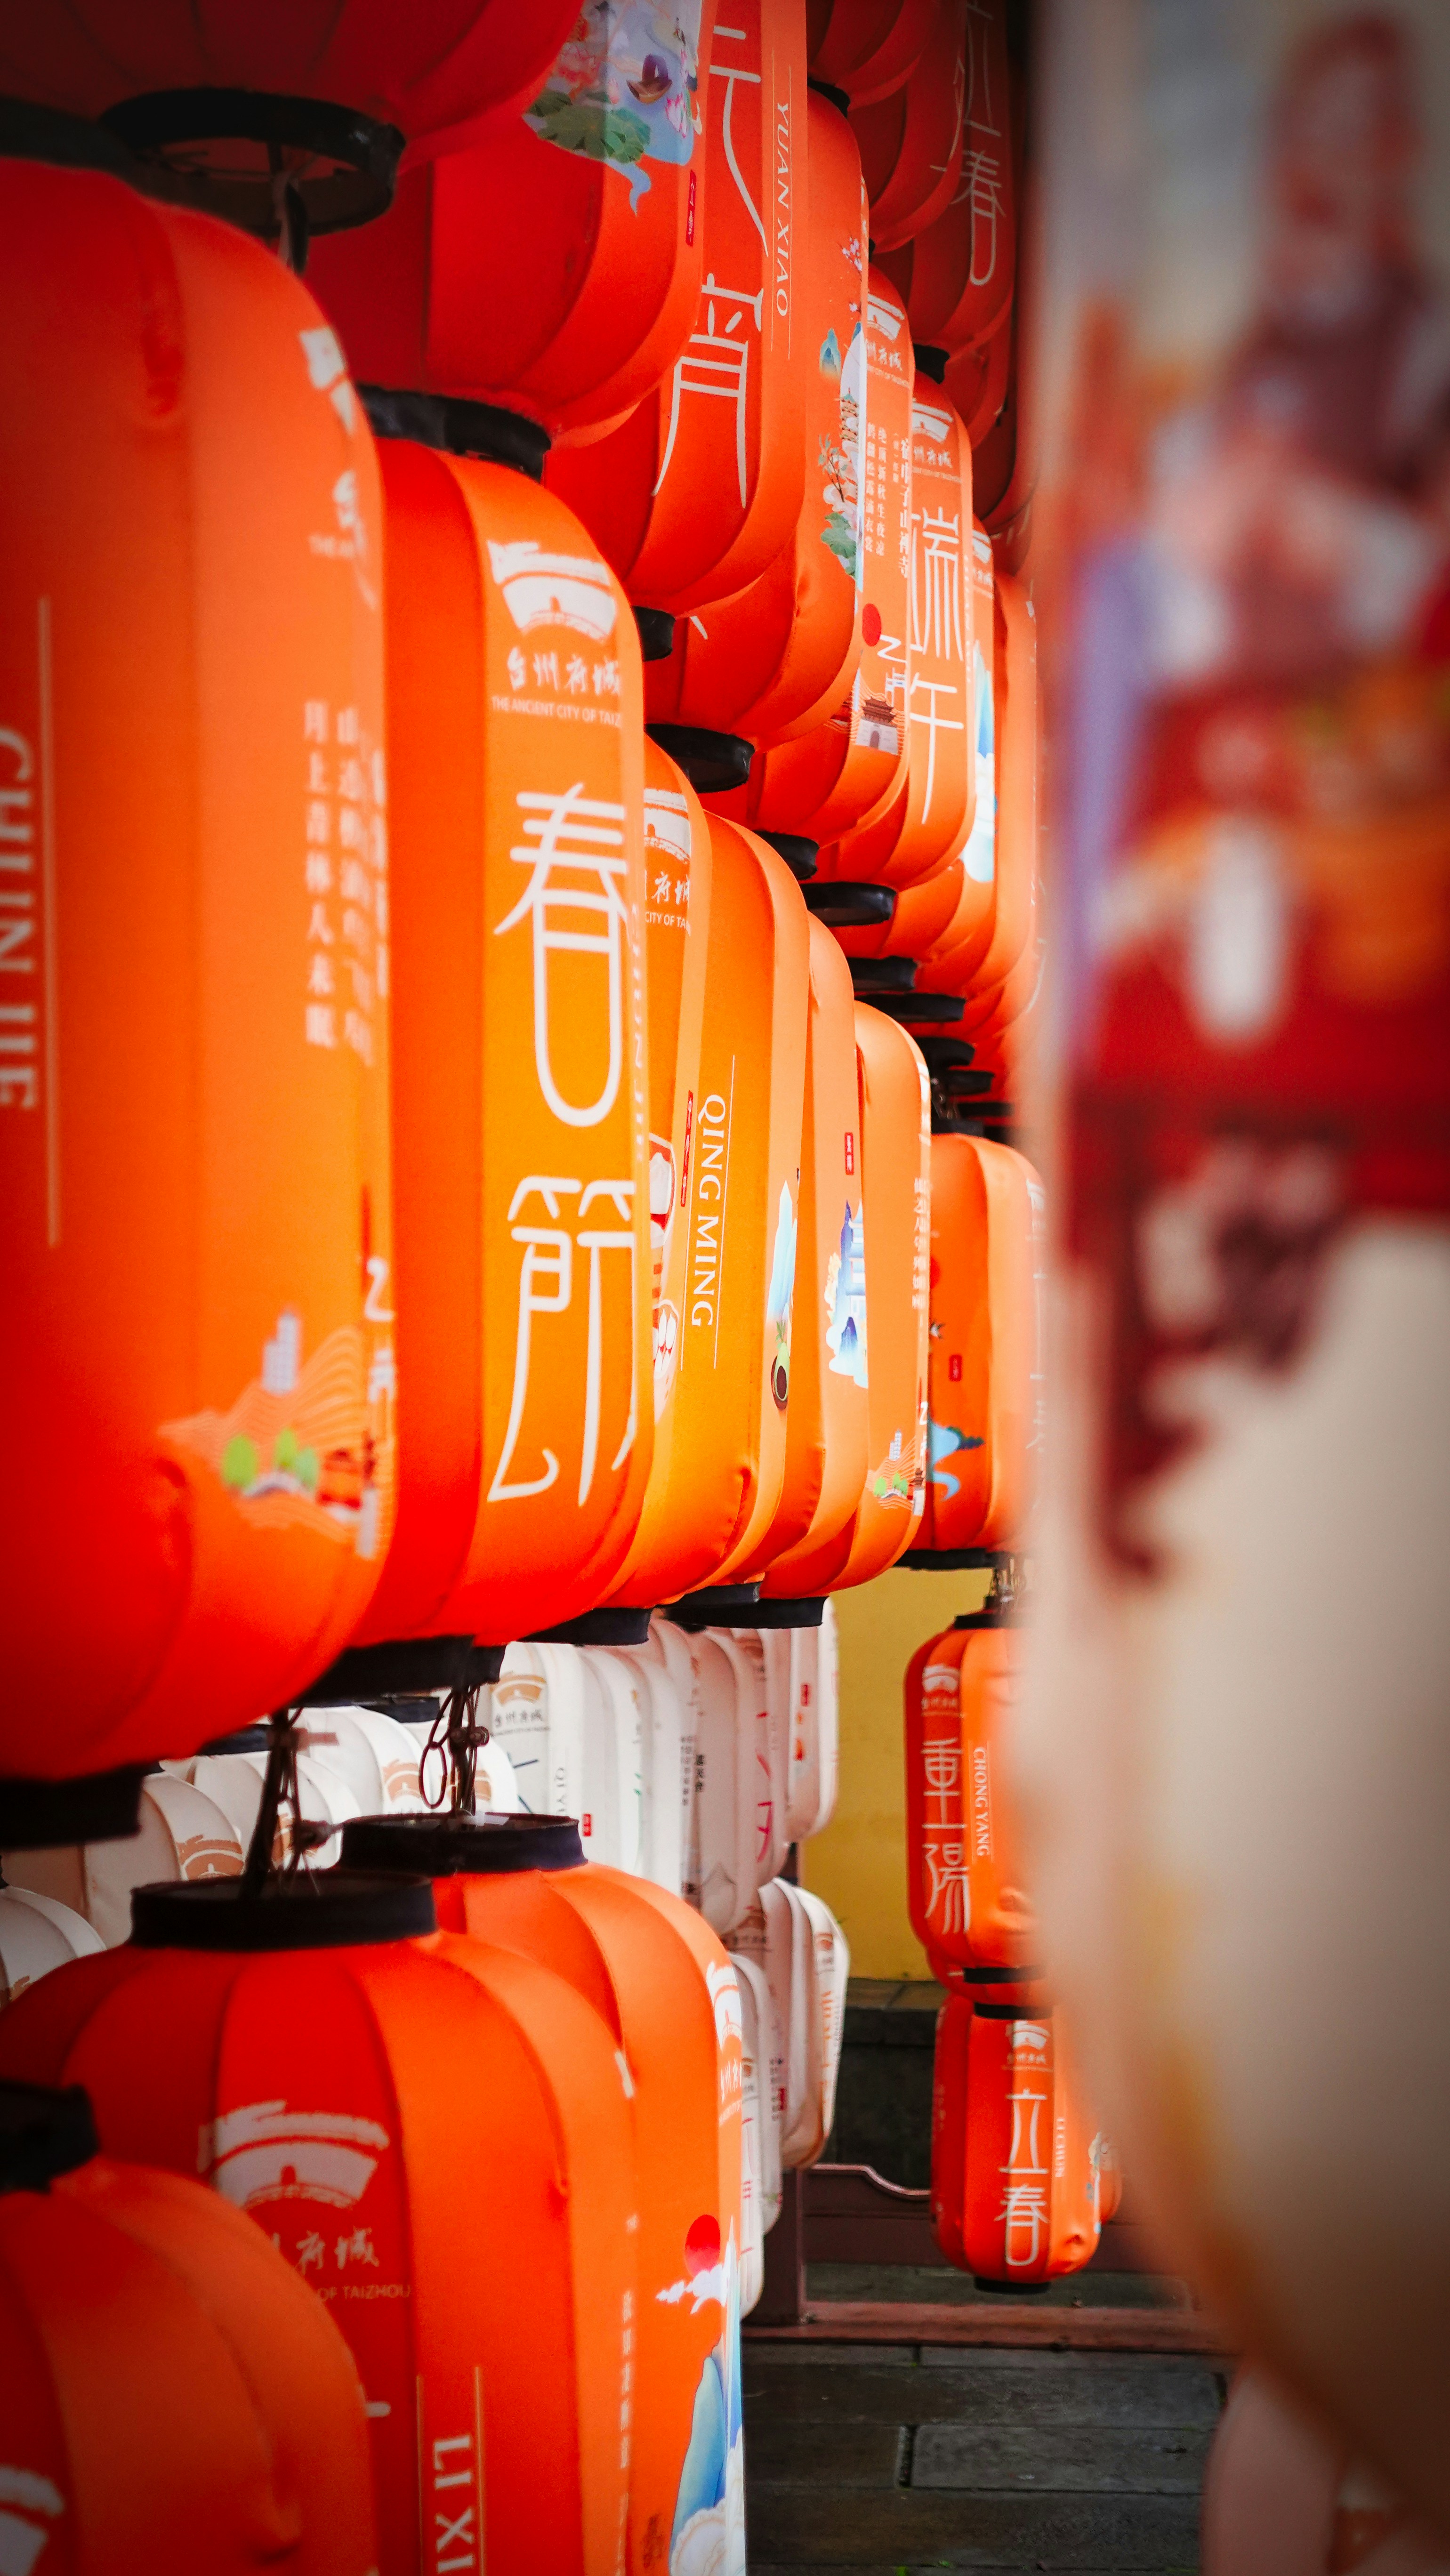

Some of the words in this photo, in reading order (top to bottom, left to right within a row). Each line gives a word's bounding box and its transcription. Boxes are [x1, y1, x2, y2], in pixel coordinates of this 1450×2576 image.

[776, 102, 789, 211] YUAN
[776, 217, 789, 317] XIAO
[492, 696, 509, 712] THE
[511, 698, 555, 716] ANCIENT
[557, 703, 580, 720] CITY
[582, 708, 596, 724] OF
[599, 710, 622, 729] TAIZ
[645, 910, 662, 925] CITY
[663, 915, 675, 927] OF
[697, 1095, 725, 1203] QING
[691, 1215, 720, 1327] MING
[973, 1746, 989, 1808] CHONG
[975, 1811, 991, 1856] YANG
[994, 2088, 1051, 2267] 立春
[343, 2284, 411, 2300] TAIZHOU
[434, 2434, 471, 2490] LI
[435, 2505, 475, 2574] XI
